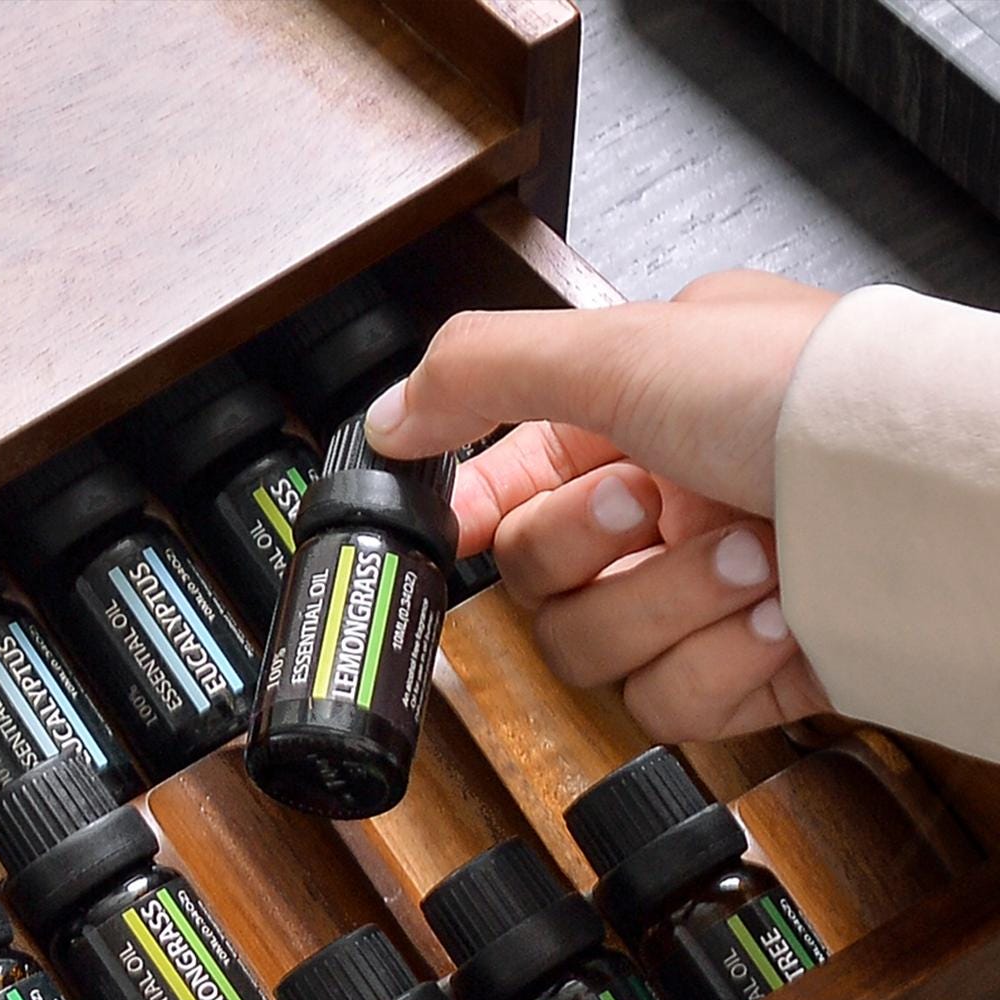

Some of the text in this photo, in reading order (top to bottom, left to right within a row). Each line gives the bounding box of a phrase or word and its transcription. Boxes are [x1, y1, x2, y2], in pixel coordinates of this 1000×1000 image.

[251, 519, 274, 549] OIL
[105, 599, 183, 711] ESSENTIAL OIL
[129, 562, 227, 696] EUCALYPTUS
[291, 568, 329, 686] ESSENTIAL OIL
[332, 551, 382, 702] LEMONGRASS
[119, 941, 144, 973] OIL
[723, 949, 748, 979] OIL
[760, 927, 806, 983] TREE
